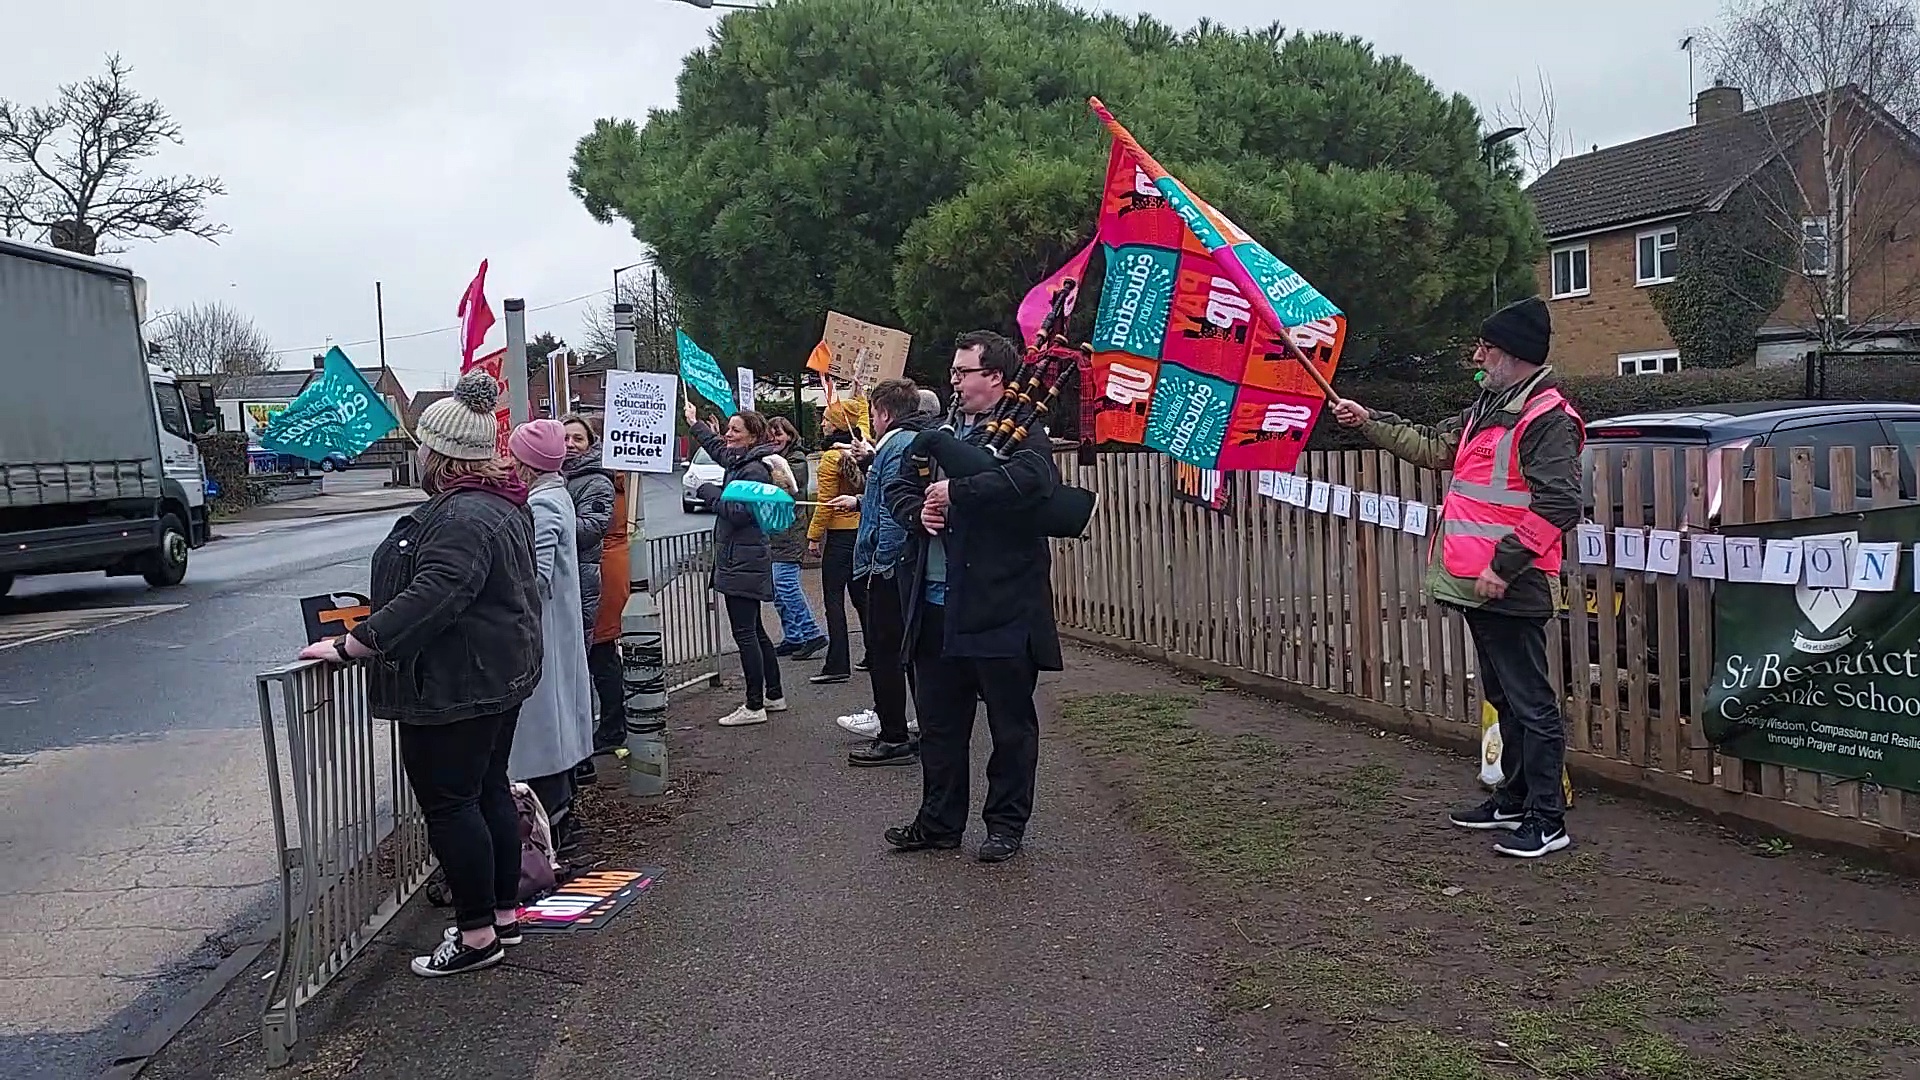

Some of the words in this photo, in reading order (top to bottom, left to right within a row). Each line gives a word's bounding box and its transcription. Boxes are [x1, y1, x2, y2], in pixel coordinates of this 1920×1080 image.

[613, 397, 666, 411] education
[627, 392, 654, 400] national
[610, 429, 667, 445] Official
[613, 443, 663, 458] picket
[1276, 476, 1422, 528] NATIONA
[1586, 535, 1890, 580] DUCATION
[1722, 654, 1753, 689] St
[1811, 720, 1868, 740] Compassion
[1870, 732, 1889, 744] and
[1767, 733, 1805, 749] through
[1807, 736, 1837, 753] Prayer
[1838, 744, 1856, 756] and
[1858, 745, 1884, 760] Work
